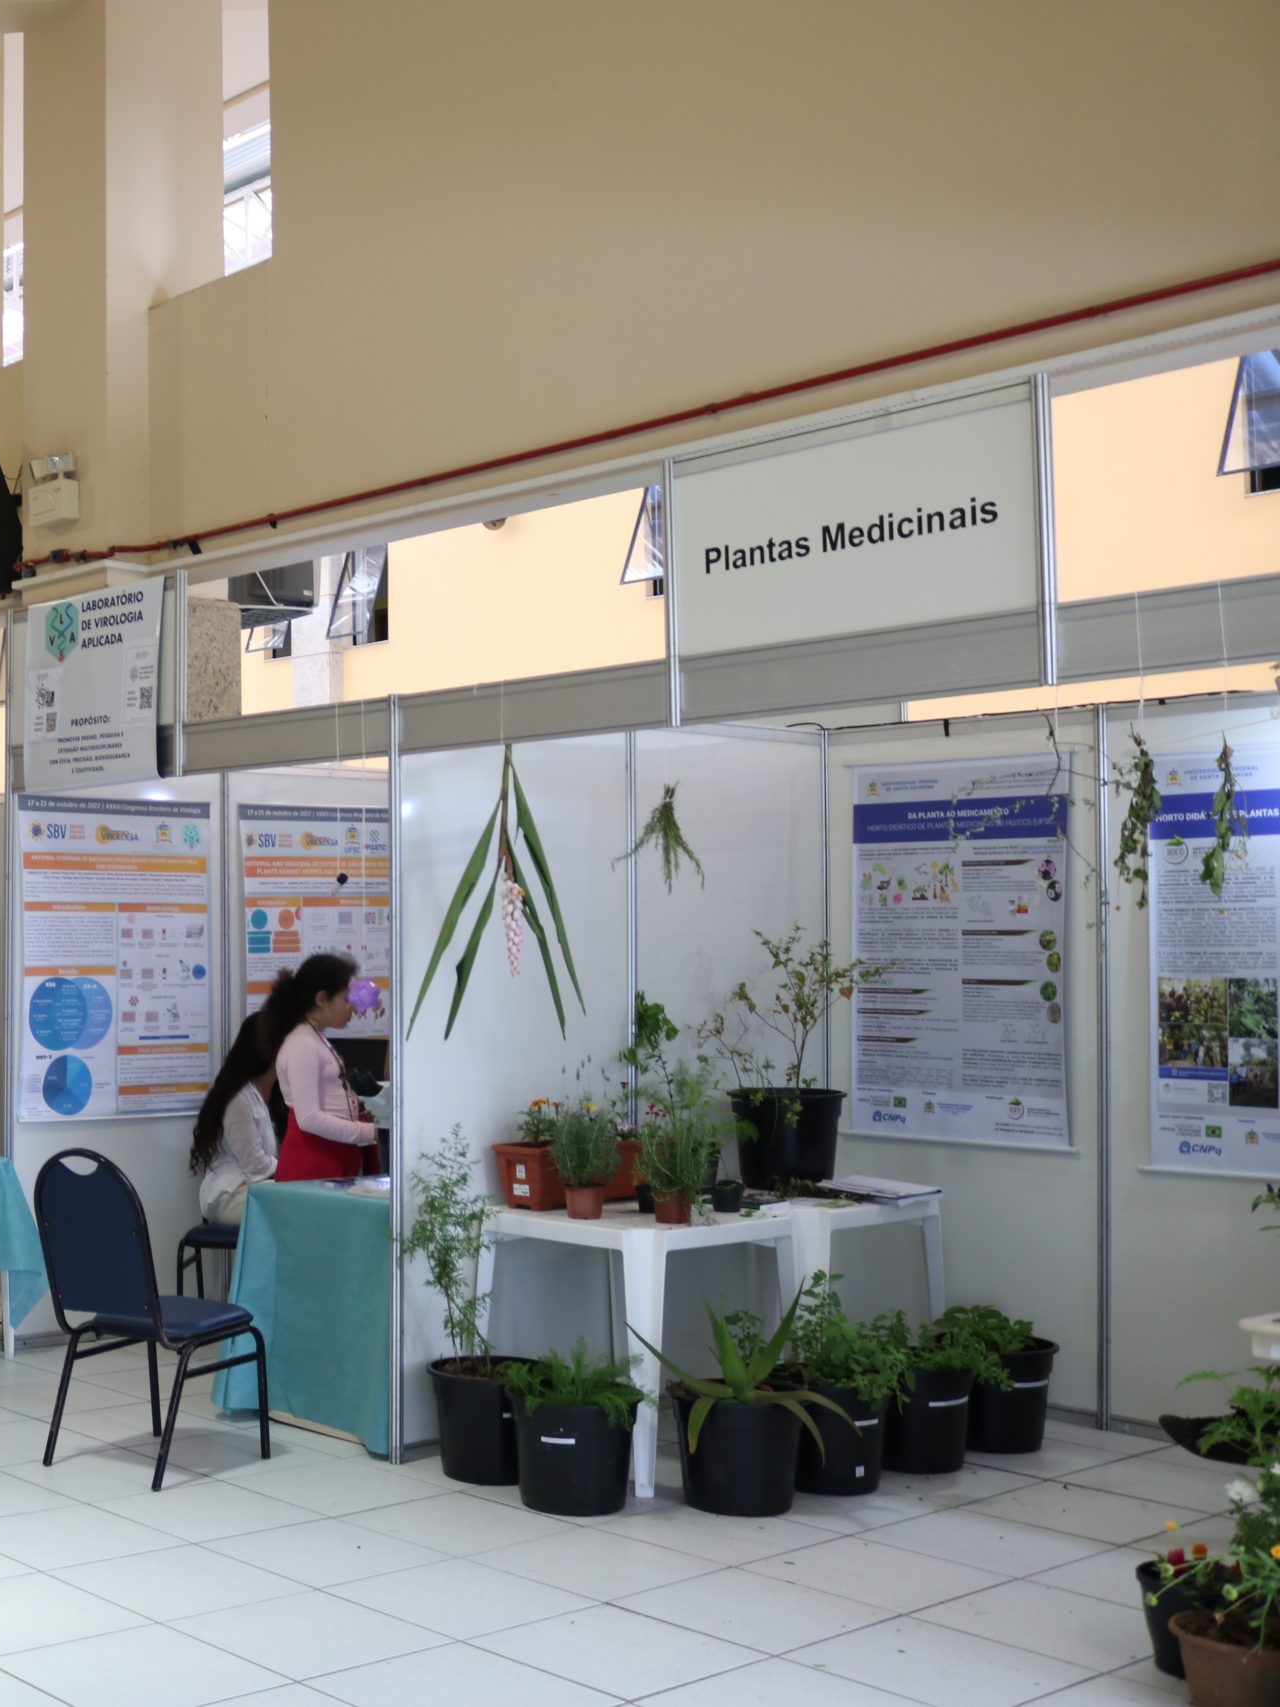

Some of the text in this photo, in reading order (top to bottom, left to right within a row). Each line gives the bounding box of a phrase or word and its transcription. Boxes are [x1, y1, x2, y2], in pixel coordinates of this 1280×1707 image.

[704, 497, 999, 575] Plantas Medicinais
[81, 591, 144, 613] LABORATÓRIO
[81, 610, 144, 631] DE VIROLOGIA
[81, 632, 123, 649] APLICADA
[70, 715, 111, 727] PROPÓSITO:
[908, 812, 918, 820] DA
[918, 810, 945, 819] PLANTA
[957, 807, 1009, 817] MEDICAMETO
[46, 823, 67, 839] SBV
[258, 833, 277, 848] SBV
[882, 1111, 907, 1125] CNPq
[1191, 1143, 1223, 1157] CNPq
